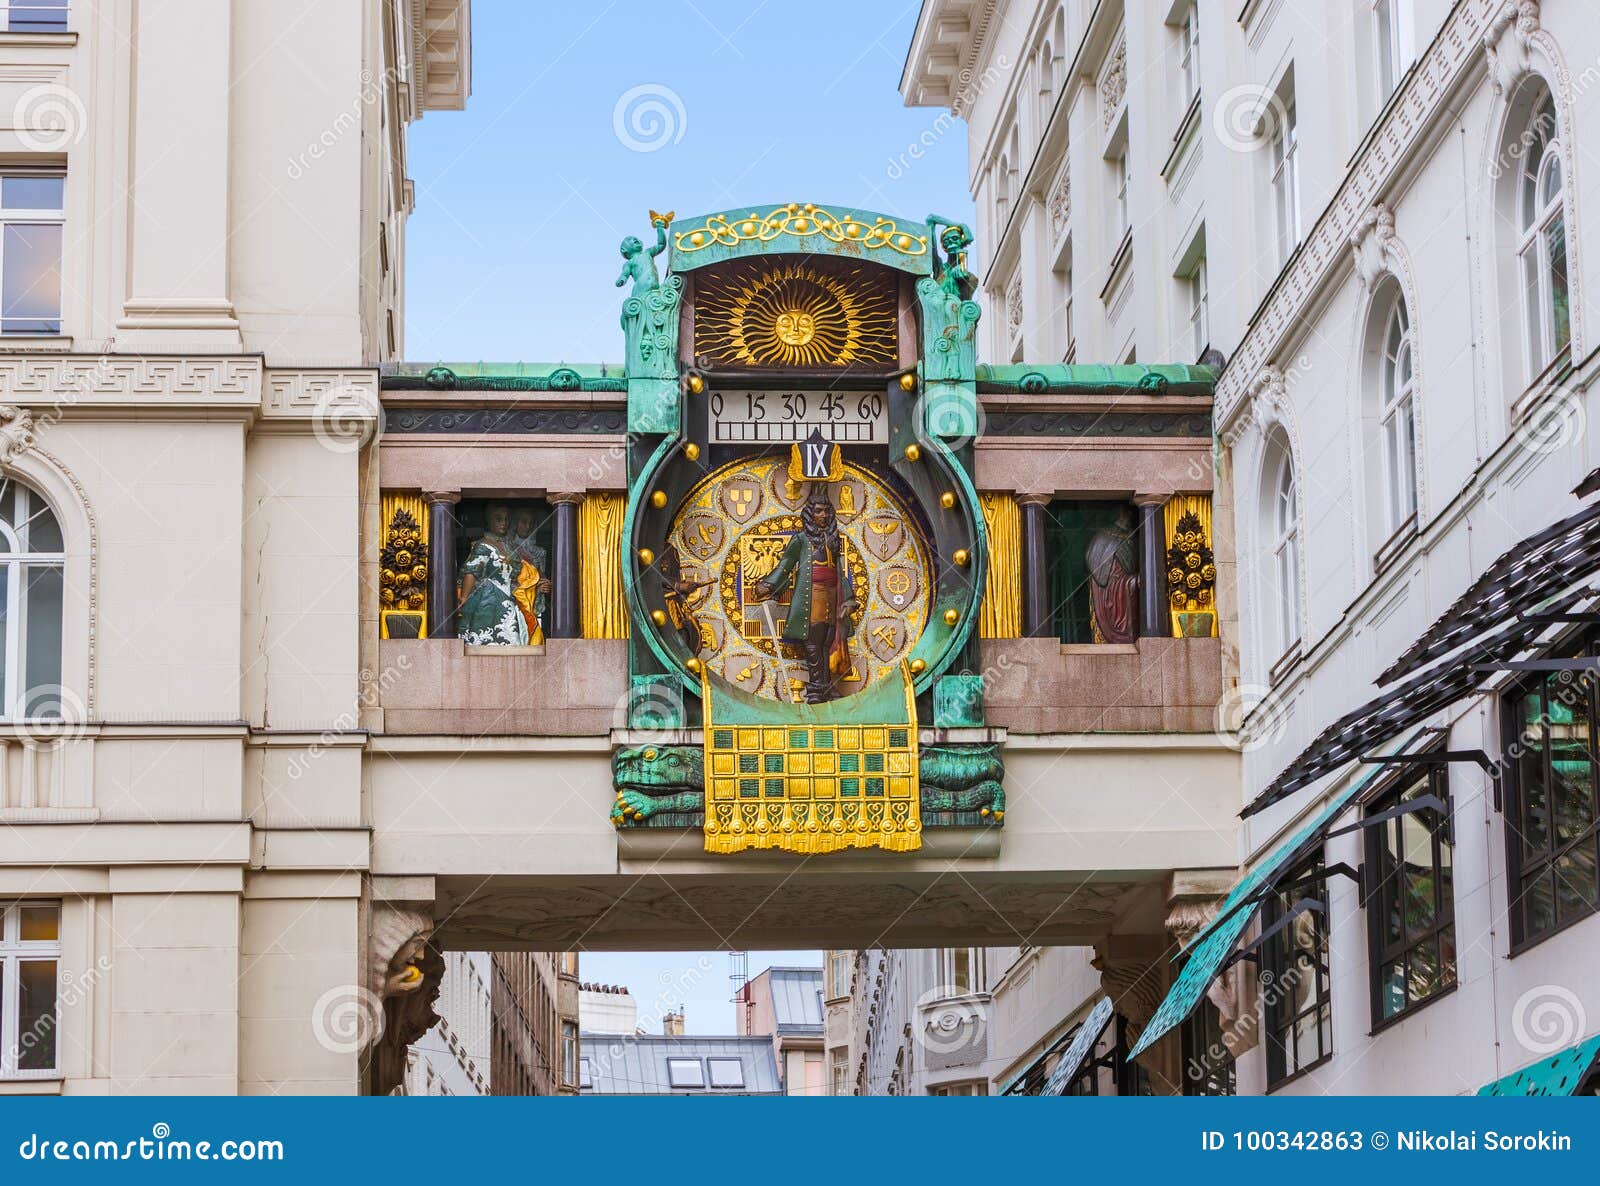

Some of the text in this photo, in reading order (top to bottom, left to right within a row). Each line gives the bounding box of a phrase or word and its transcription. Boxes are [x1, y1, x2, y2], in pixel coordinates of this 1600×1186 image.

[711, 393, 882, 420] 0 15 30 45 60
[806, 443, 829, 477] IX
